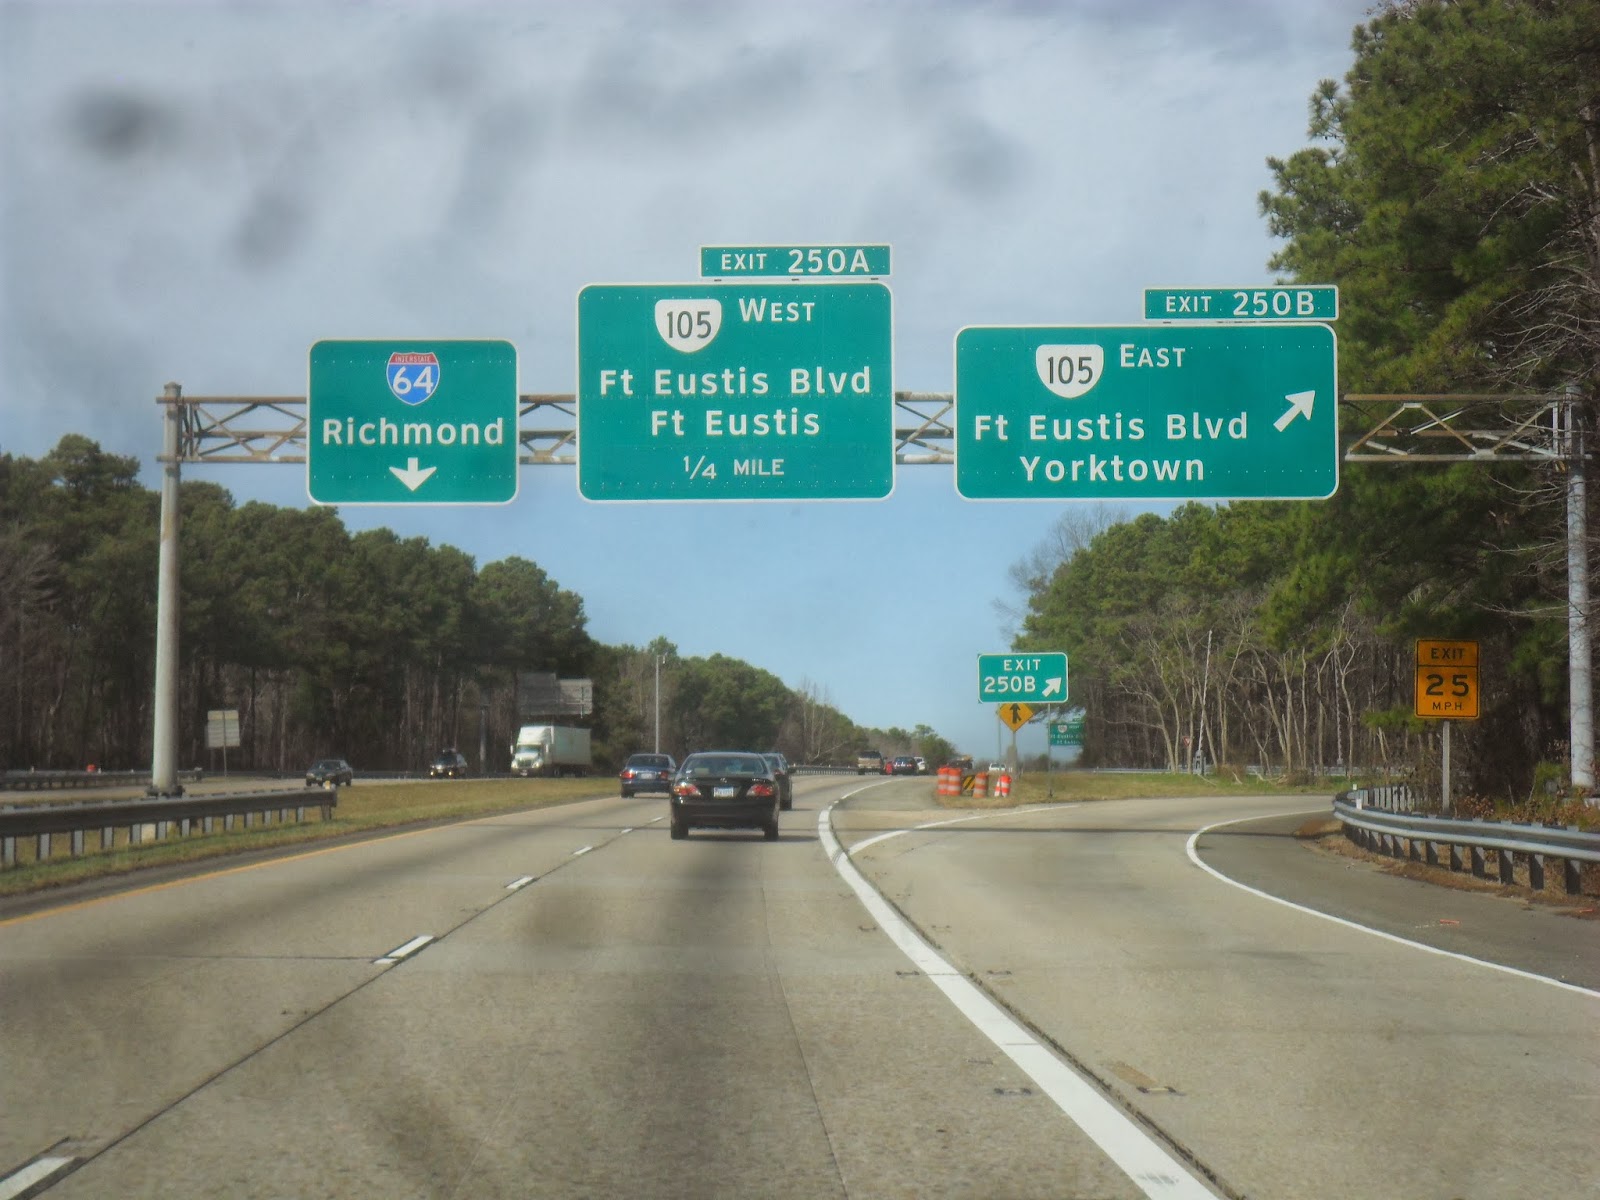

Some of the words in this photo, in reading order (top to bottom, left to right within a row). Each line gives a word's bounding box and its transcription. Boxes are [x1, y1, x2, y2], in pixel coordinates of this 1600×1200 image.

[721, 252, 767, 270] EXIT
[787, 248, 869, 273] 250A
[738, 299, 815, 322] WEST
[1165, 295, 1211, 312] EXIT
[1232, 291, 1315, 315] 250B
[665, 311, 713, 339] 105
[395, 355, 431, 363] INTERSTATE
[1119, 344, 1186, 367] EAST
[393, 366, 434, 394] 64
[599, 369, 634, 395] Ft
[654, 366, 769, 395] Eustis
[790, 366, 871, 394] Blvd
[1046, 356, 1094, 385] 105
[322, 417, 503, 445] Richmond
[651, 410, 685, 436] Ft
[705, 407, 820, 436] Eustis
[974, 415, 1009, 440] Ft
[1030, 412, 1145, 440] Eustis
[1166, 412, 1248, 440] Blvd
[733, 459, 785, 476] MILE
[1020, 454, 1205, 481] Yorktown
[1003, 659, 1041, 671] EXIT
[1431, 647, 1465, 660] EXIT
[984, 676, 1036, 693] 250B
[1426, 674, 1469, 697] 25
